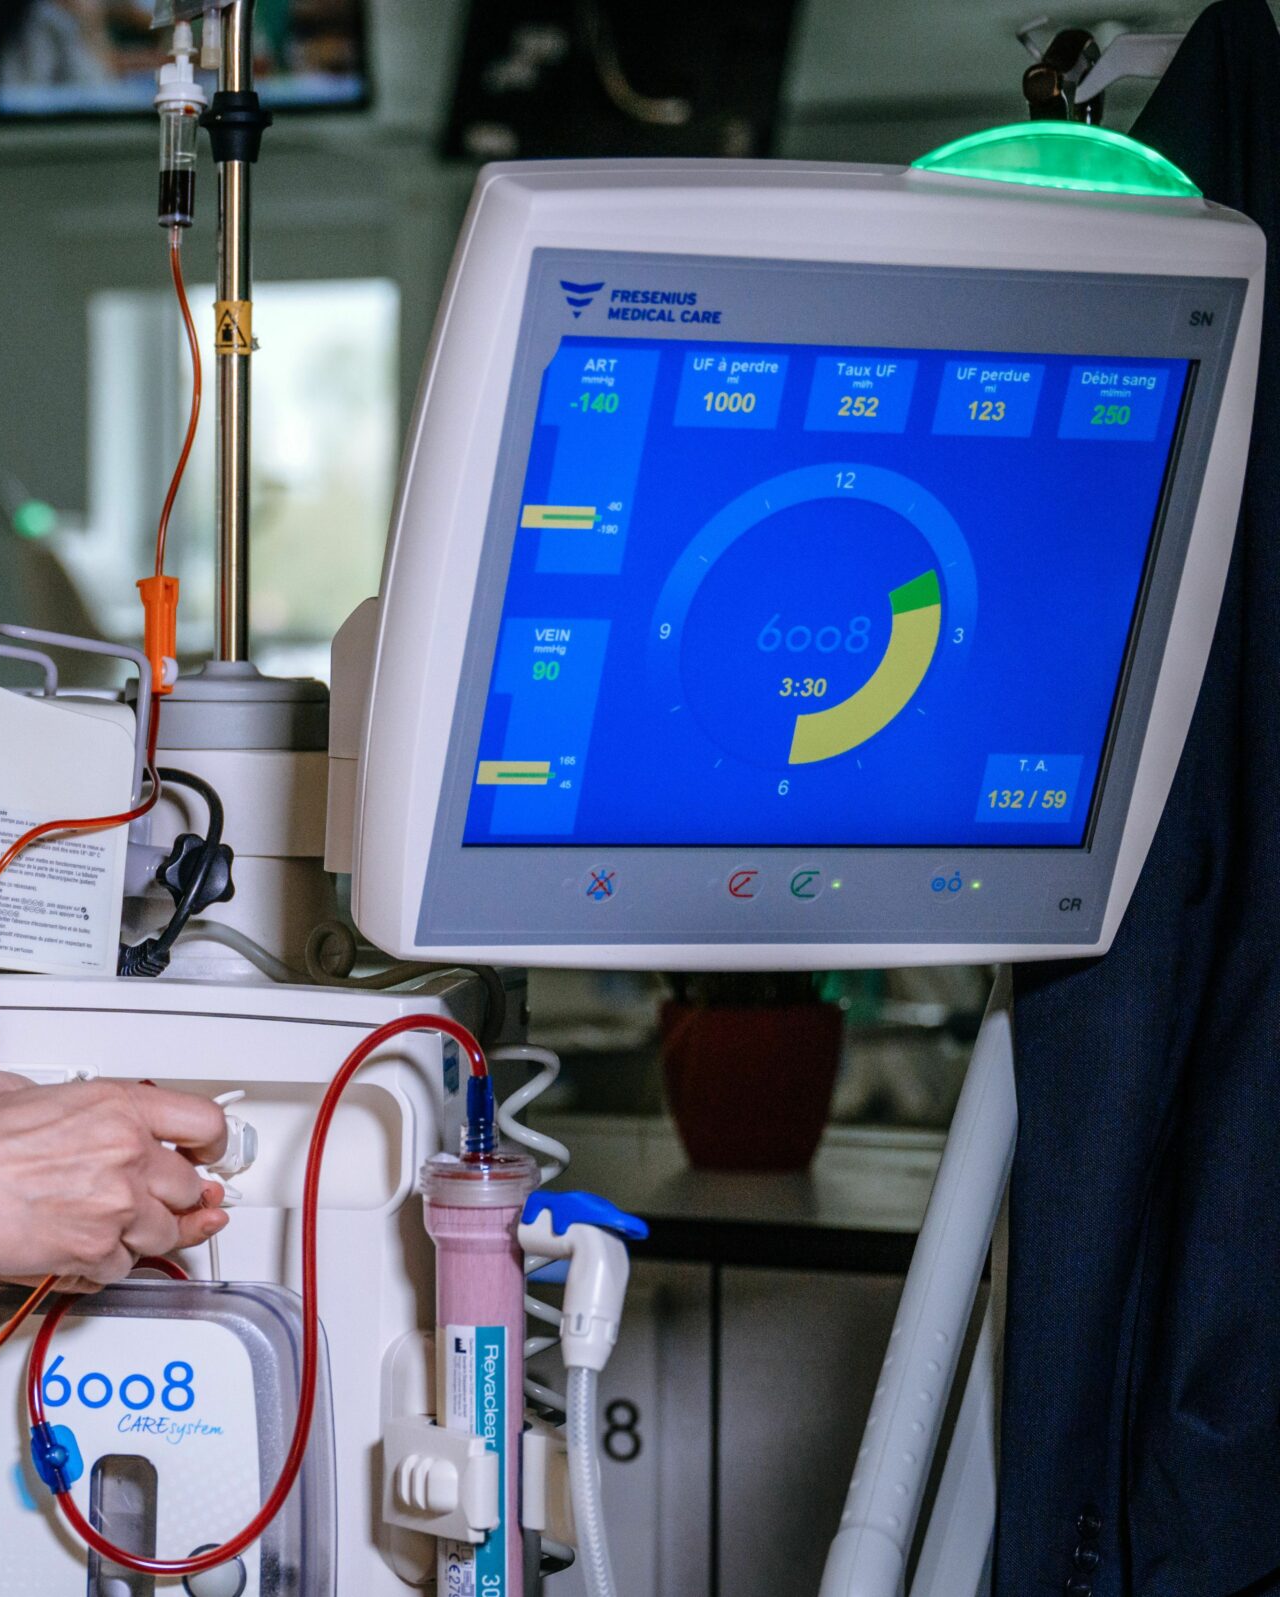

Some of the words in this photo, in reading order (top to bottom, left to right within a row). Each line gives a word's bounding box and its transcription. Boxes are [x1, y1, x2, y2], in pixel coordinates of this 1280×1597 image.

[610, 290, 697, 306] FRESENIUS
[607, 307, 676, 322] MEDICAL
[680, 310, 722, 324] CARE
[1189, 311, 1214, 327] SN
[584, 359, 617, 372] ART
[693, 358, 713, 371] UF
[718, 357, 727, 372] à
[730, 360, 779, 375] perdre
[837, 363, 872, 376] Taux
[876, 364, 897, 377] UF
[957, 367, 977, 381] UF
[980, 369, 1031, 383] perdue
[1081, 371, 1119, 386] Débit
[1122, 375, 1156, 389] sang
[571, 392, 619, 413] -140
[703, 392, 756, 413] 1000
[838, 396, 879, 417] 252
[968, 401, 1006, 422] 123
[1090, 405, 1131, 426] 250
[835, 472, 856, 489] 12
[535, 628, 571, 642] VEIN
[659, 622, 671, 640] 9
[952, 627, 964, 644] 3
[532, 661, 560, 681] 90
[779, 678, 827, 698] 3:30
[777, 779, 790, 796] 6
[988, 789, 1025, 809] 132
[1041, 790, 1067, 809] 59
[1058, 897, 1083, 912] CR
[484, 1344, 499, 1448] Revaclear
[602, 1398, 643, 1463] 8
